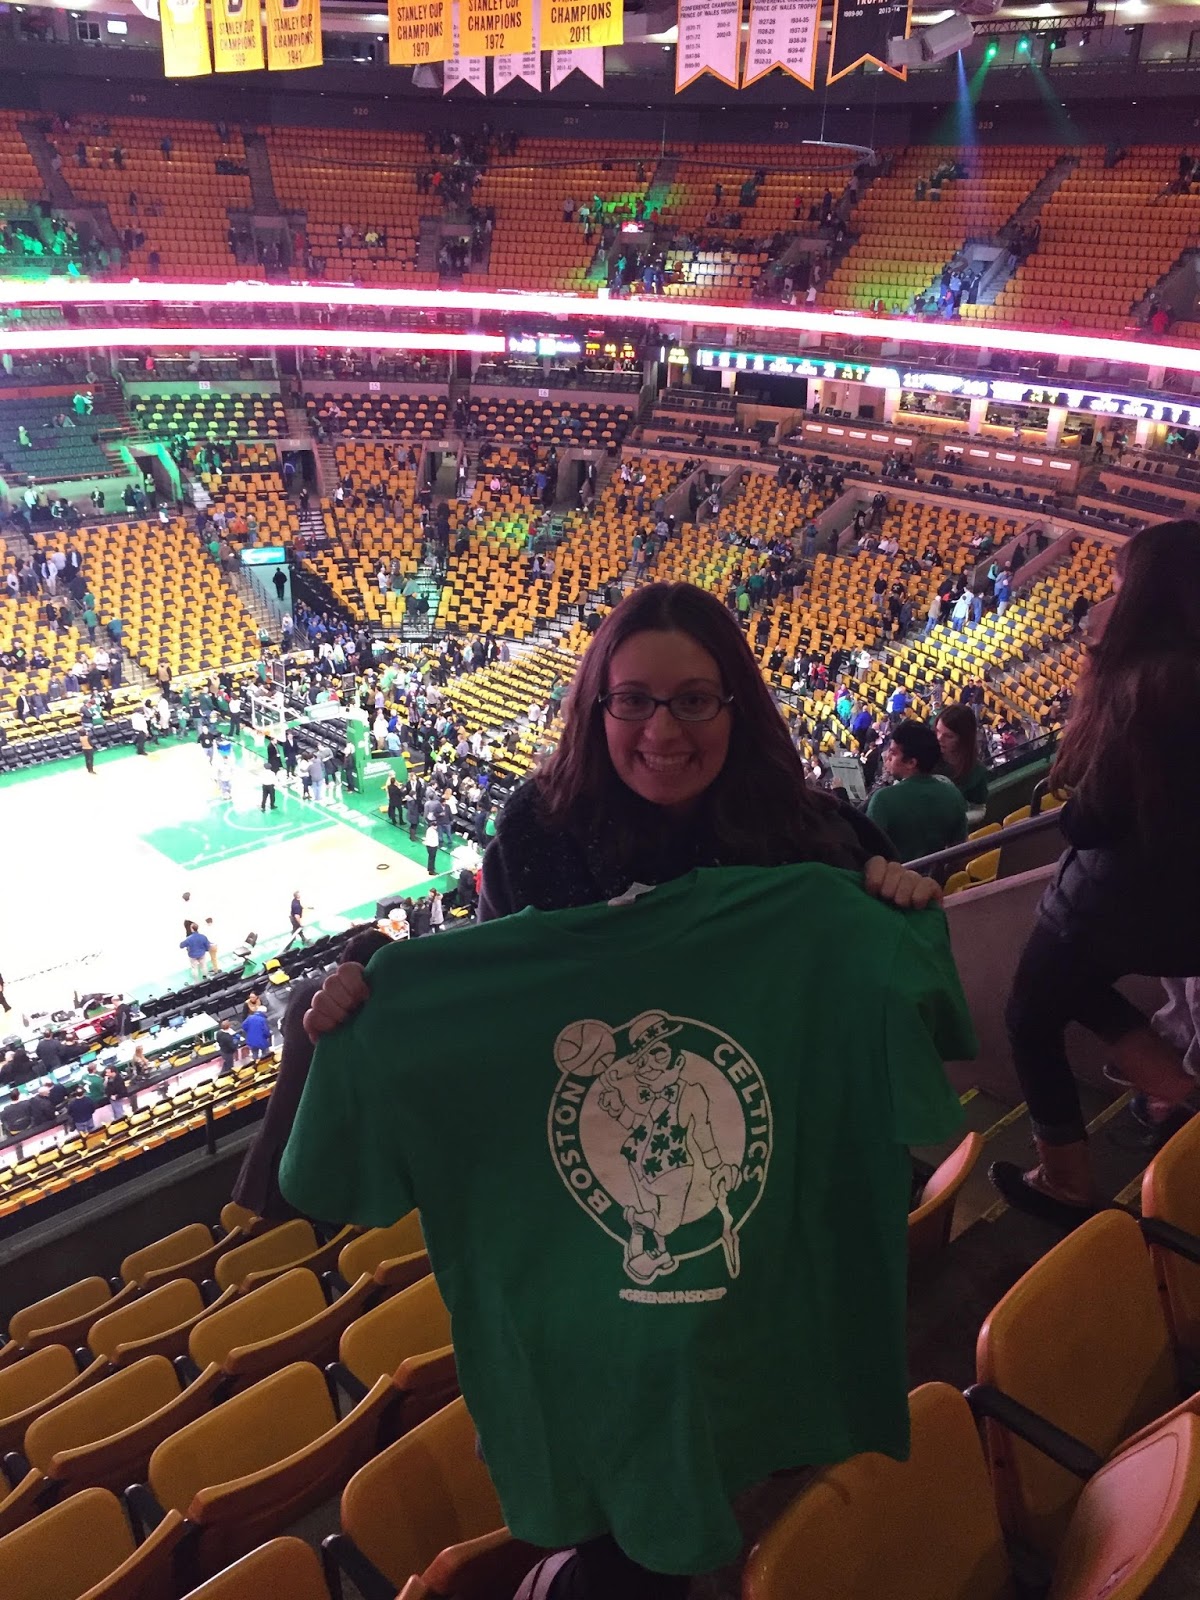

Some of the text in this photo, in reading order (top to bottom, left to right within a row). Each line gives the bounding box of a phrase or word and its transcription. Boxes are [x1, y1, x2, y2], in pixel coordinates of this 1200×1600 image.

[397, 2, 443, 21] STANLEY CUP
[551, 2, 612, 23] CHAMPIONS
[274, 13, 313, 32] STANLEY CUP
[397, 21, 443, 40] CHAMPIONS
[468, 12, 522, 31] CHAMPIONS
[274, 31, 313, 48] CHAMPIONS
[485, 33, 505, 49] 1972
[570, 25, 591, 43] 2011
[412, 42, 430, 57] 1970
[713, 1043, 769, 1182] CELTICS
[554, 1082, 612, 1214] BOSTON
